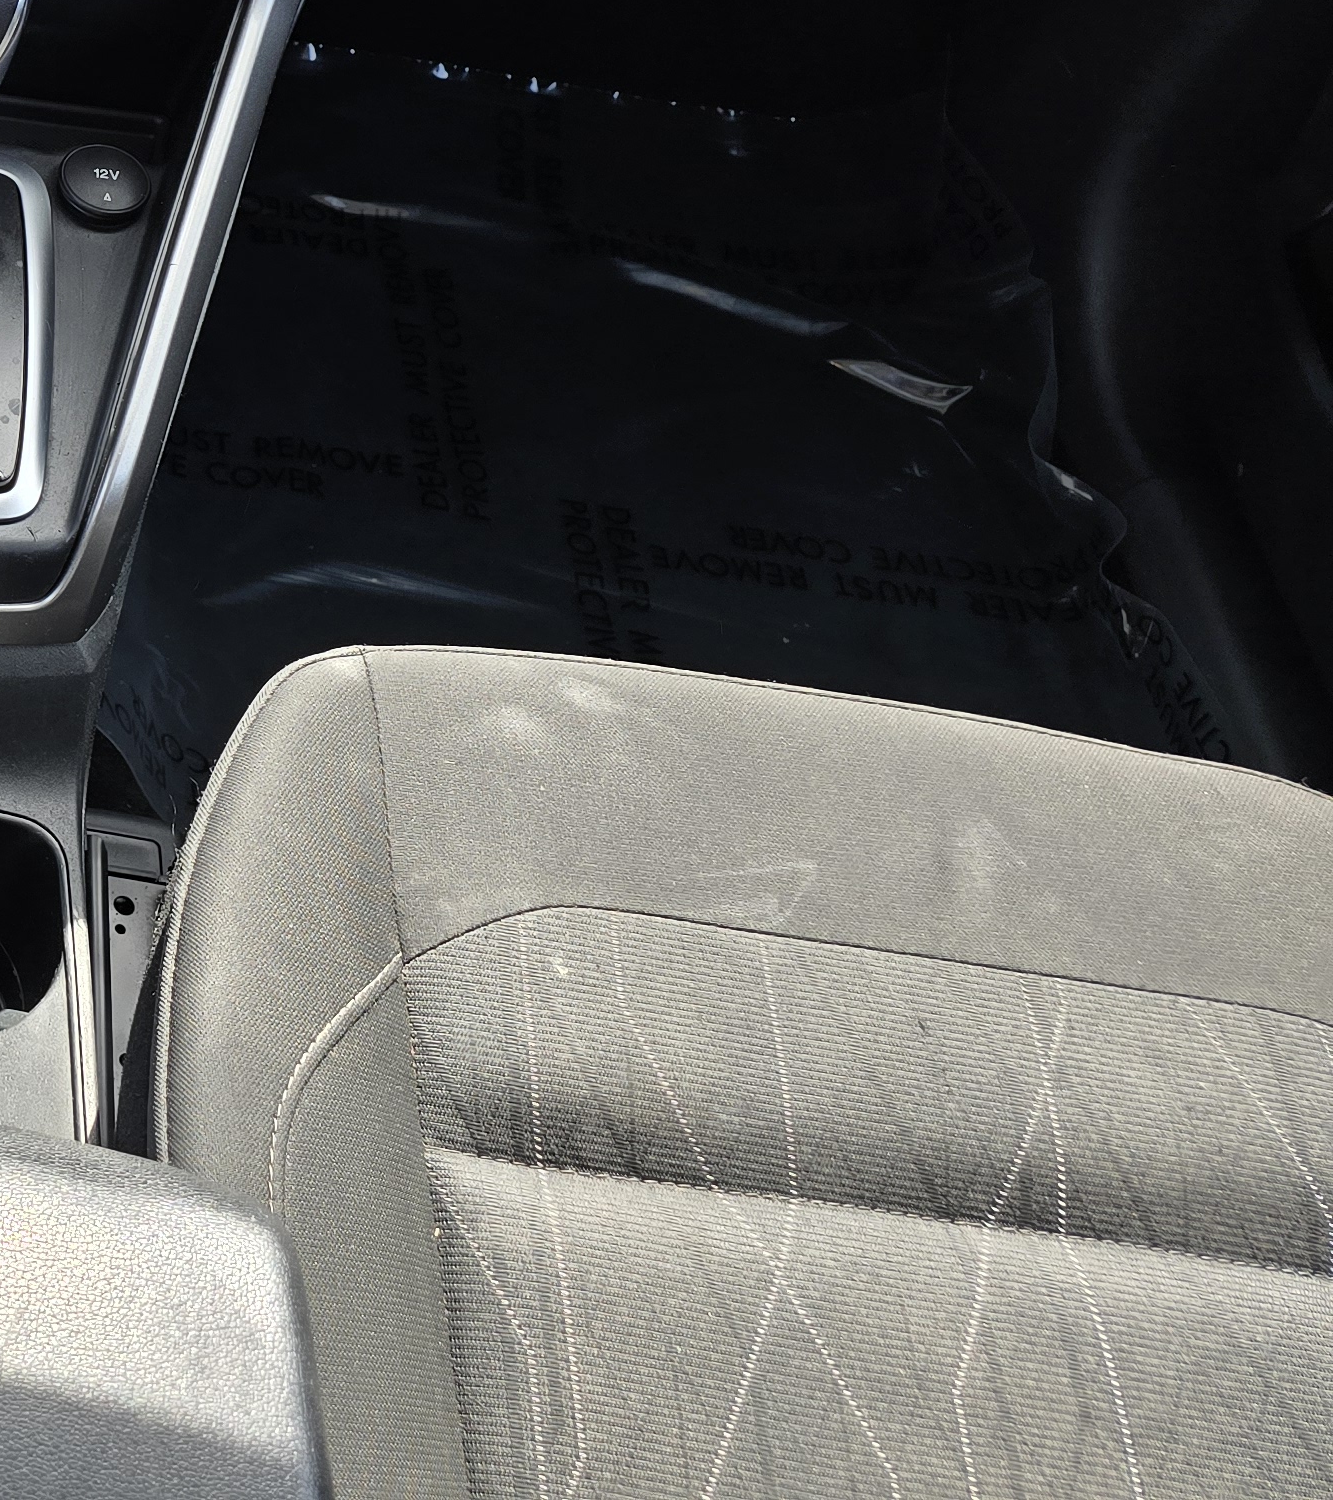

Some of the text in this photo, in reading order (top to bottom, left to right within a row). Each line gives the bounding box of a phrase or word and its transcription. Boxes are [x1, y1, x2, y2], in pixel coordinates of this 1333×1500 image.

[93, 168, 120, 181] 12V
[167, 426, 405, 479] UST REMOVE
